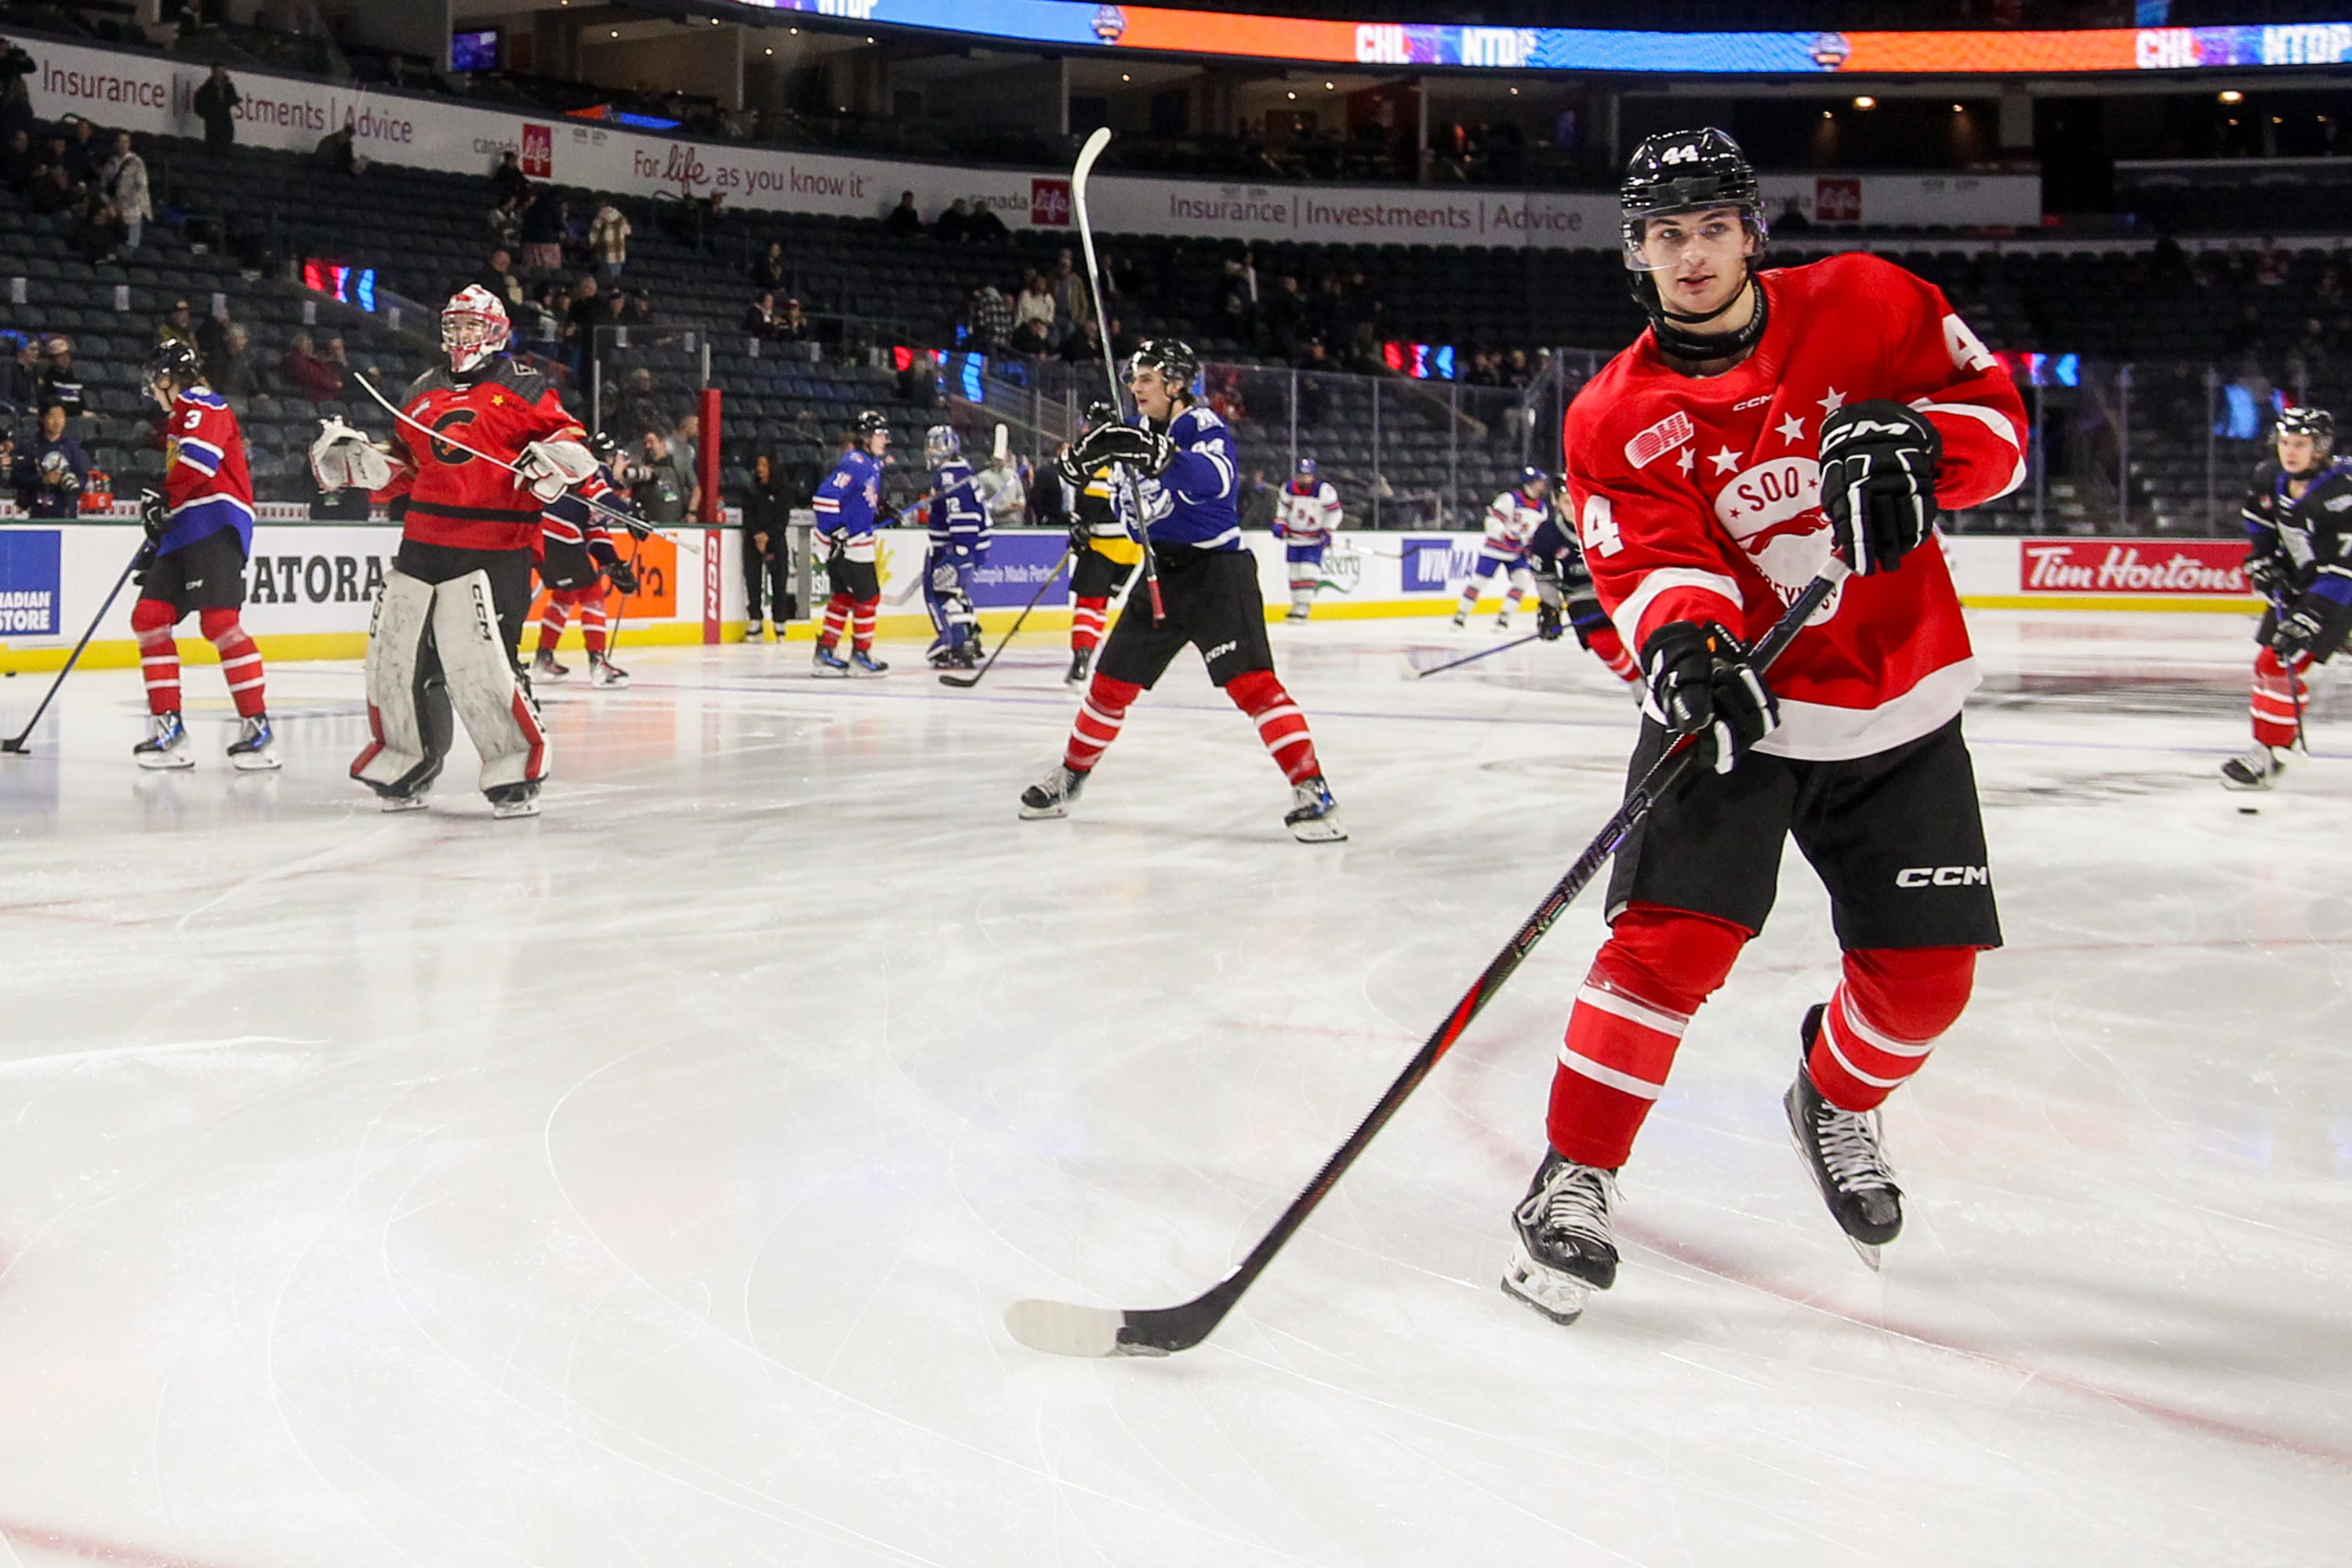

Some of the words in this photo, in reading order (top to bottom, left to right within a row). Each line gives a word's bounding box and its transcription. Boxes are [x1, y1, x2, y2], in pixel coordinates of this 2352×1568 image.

[1355, 24, 1409, 64] CHL
[2136, 30, 2200, 69] CHL
[2263, 24, 2351, 65] NTDP
[43, 60, 165, 108] Insurance
[186, 78, 325, 131] Istments
[342, 104, 413, 143] Advice
[634, 151, 659, 177] For
[662, 144, 710, 195] life
[716, 167, 739, 187] as
[746, 170, 783, 196] you
[790, 166, 844, 196] know
[850, 171, 864, 198] it
[1661, 144, 1699, 165] 44
[1170, 194, 1287, 223] Insurance
[1306, 200, 1472, 229] Investments
[1494, 204, 1583, 233] Advice
[1942, 313, 1998, 372] 4
[183, 409, 202, 430] 3
[1733, 394, 1776, 412] CCM
[1819, 419, 1911, 459] CM
[1737, 466, 1798, 511] SOO
[1582, 494, 1624, 558] 4
[241, 555, 398, 604] ATORA
[707, 535, 717, 621] CCM
[1417, 548, 1480, 582] WINMA
[2027, 546, 2094, 588] Tim
[2097, 545, 2245, 590] Hortons
[472, 584, 492, 641] CCM
[1895, 866, 1988, 888] CCM
